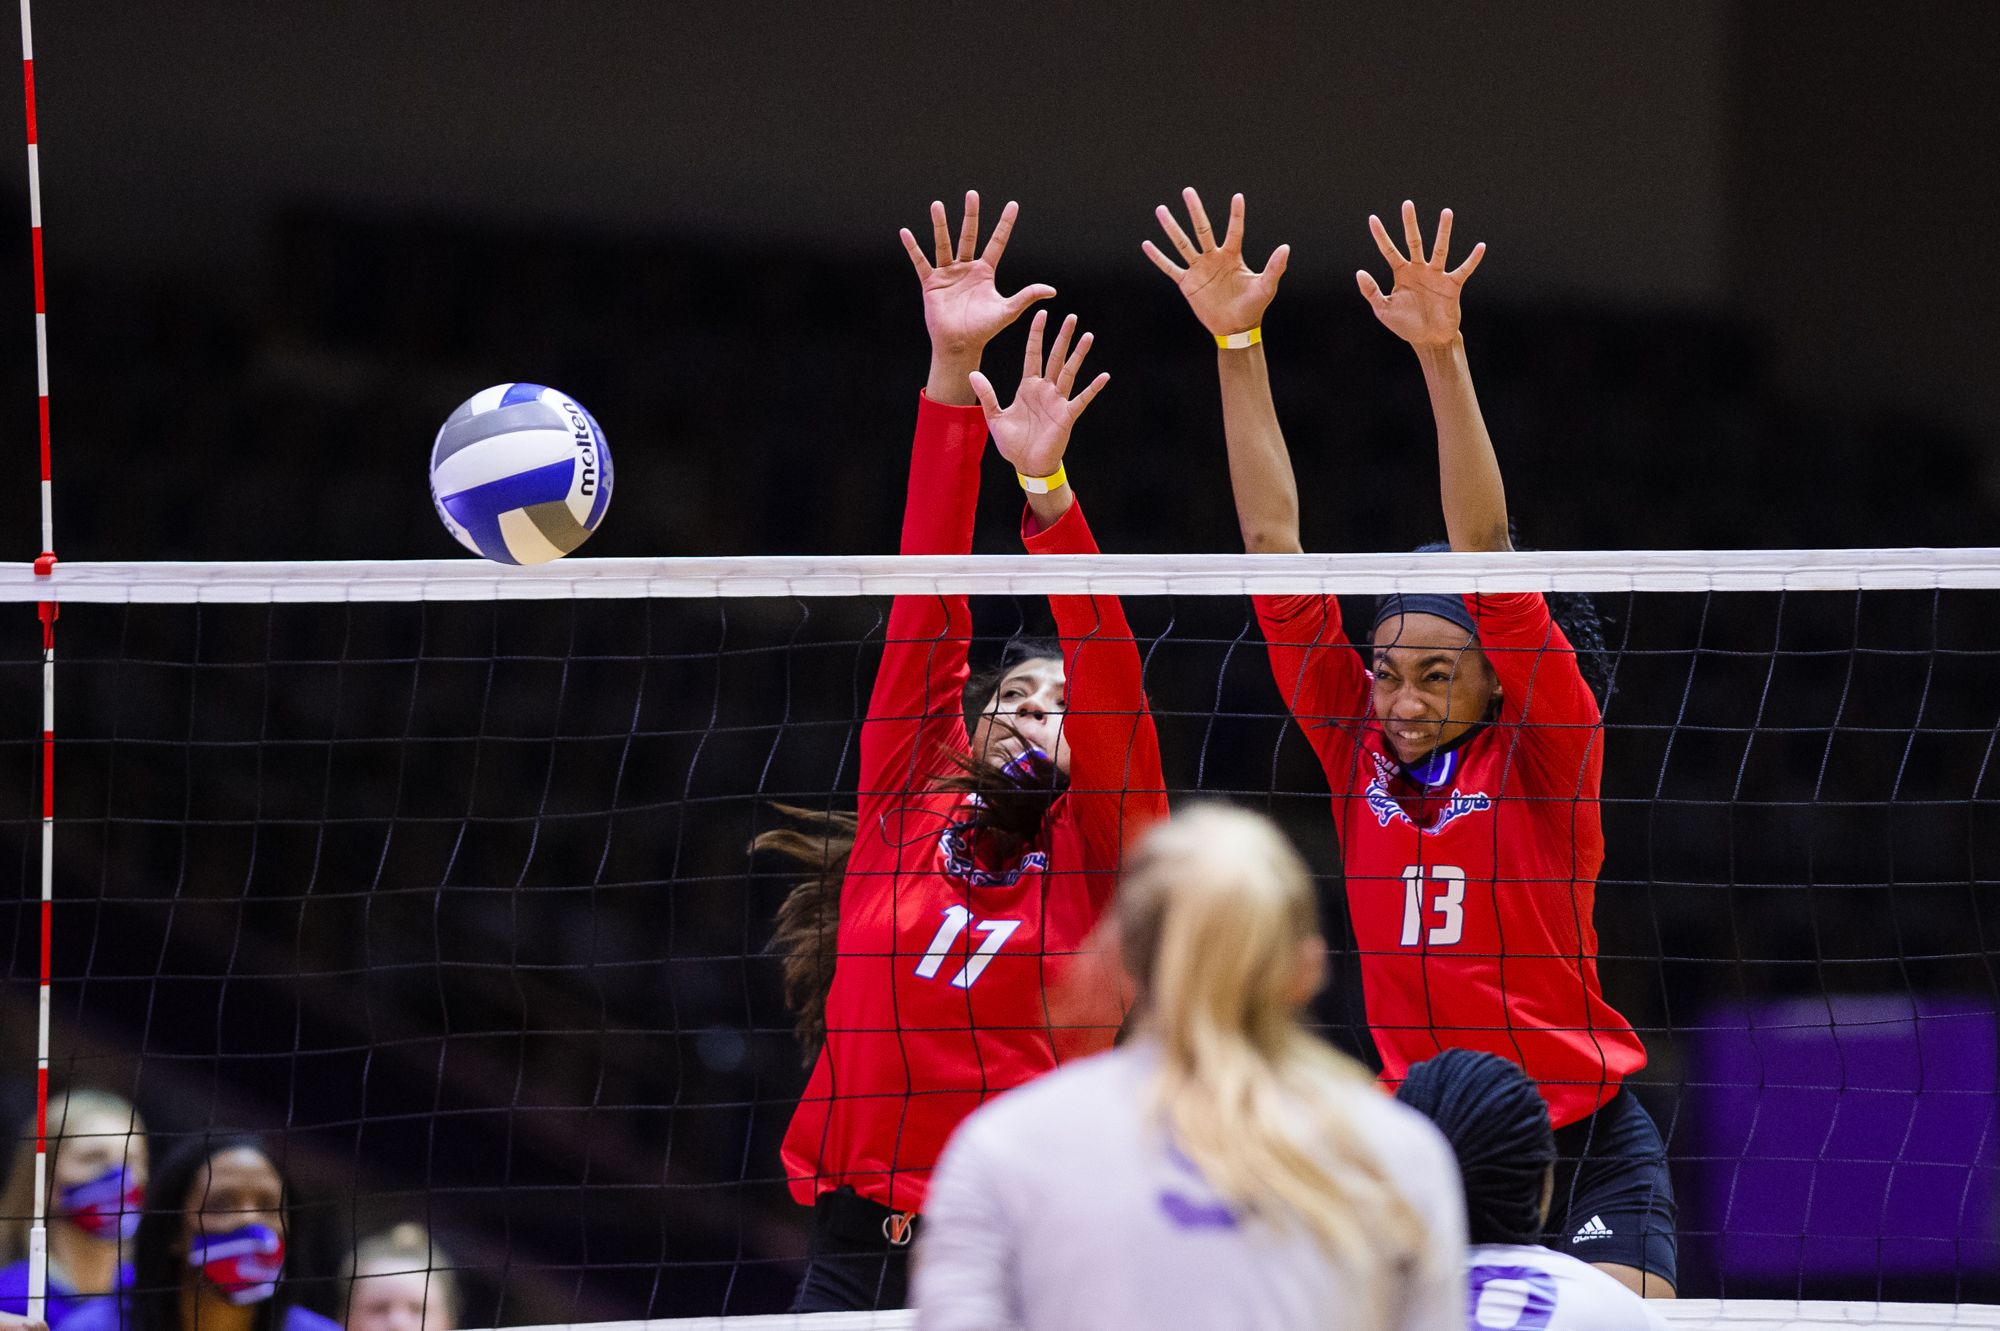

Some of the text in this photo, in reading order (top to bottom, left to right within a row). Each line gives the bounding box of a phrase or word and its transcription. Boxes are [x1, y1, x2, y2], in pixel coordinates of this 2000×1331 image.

[562, 402, 595, 496] molten
[912, 903, 1023, 990] 17
[1398, 864, 1467, 948] 13
